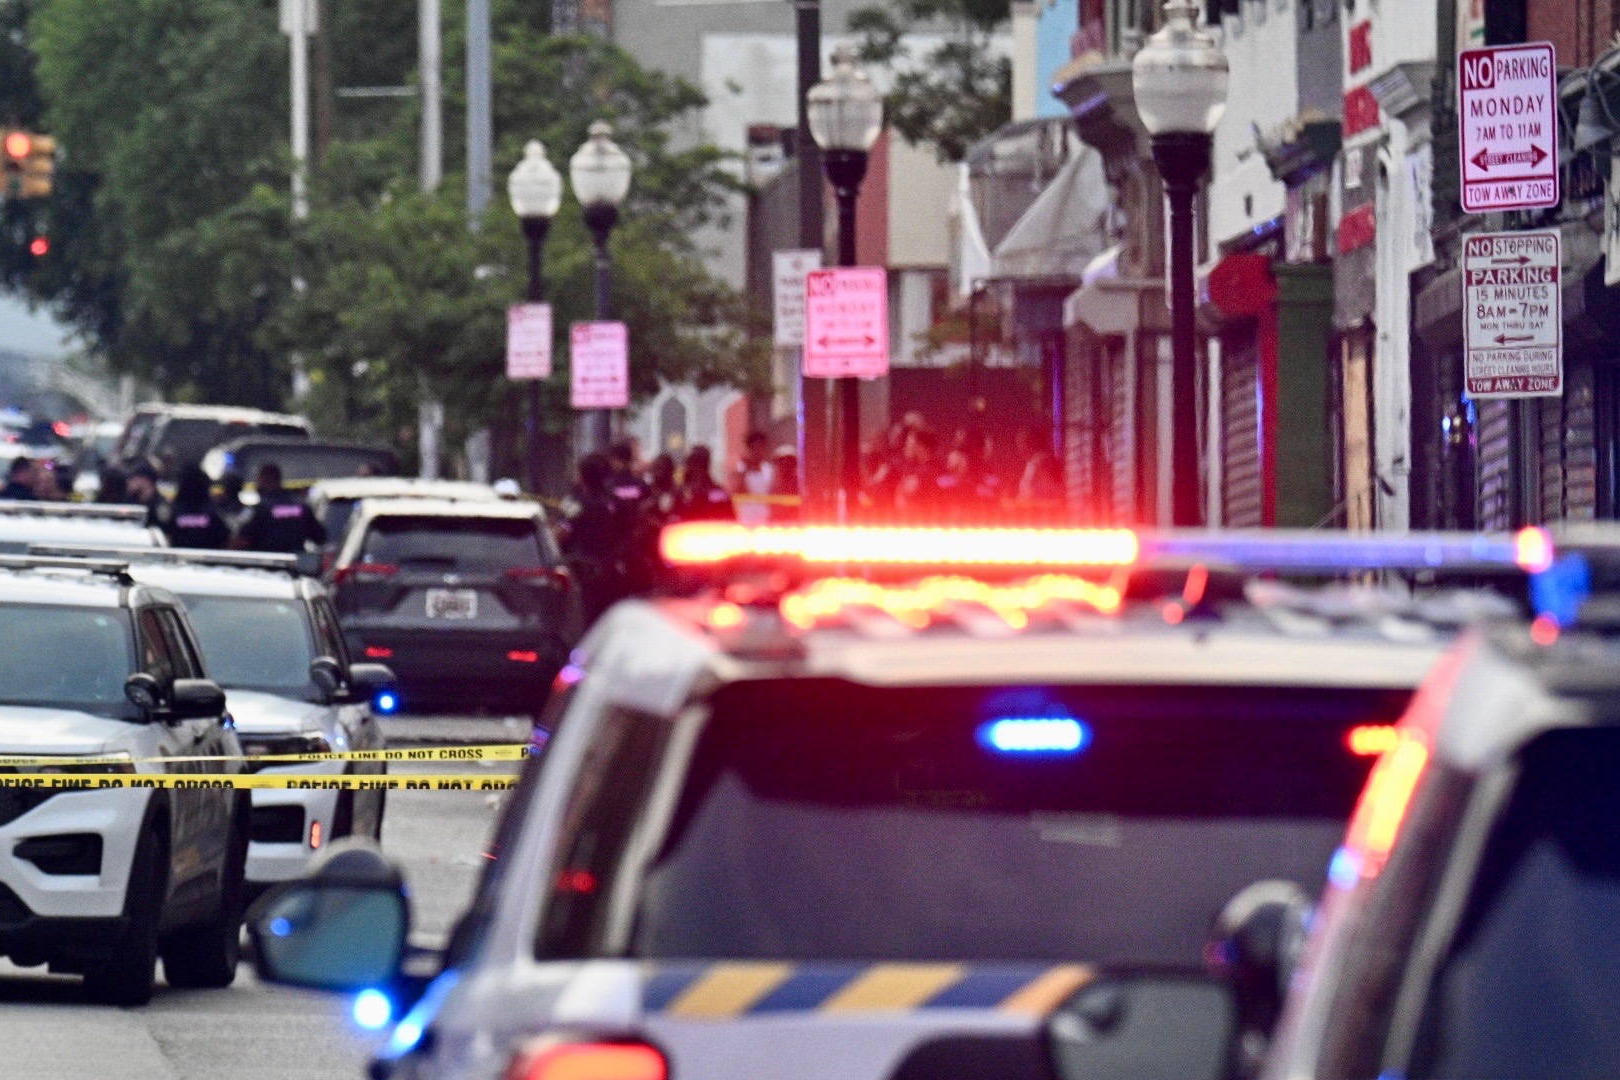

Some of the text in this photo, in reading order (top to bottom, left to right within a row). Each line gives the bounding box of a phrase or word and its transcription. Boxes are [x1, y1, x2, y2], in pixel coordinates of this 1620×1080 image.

[1464, 56, 1548, 88] NO PARKING
[1470, 95, 1544, 117] MONDAY
[1476, 122, 1542, 142] 7AM TO 11AM
[1480, 150, 1538, 166] STREET CLEANING
[1468, 182, 1552, 203] TOW AWAY ZONE
[1468, 238, 1553, 257] NO STOPPING
[1471, 269, 1552, 285] PARKING
[1476, 285, 1549, 300] 15 MINUTES
[1480, 321, 1545, 331] MON THRU SAT
[1472, 350, 1553, 363] NO PARKING DURING
[1472, 365, 1496, 375] STREET
[1497, 364, 1530, 375] CLEANING
[1472, 378, 1555, 392] TOW AWAY ZONE
[351, 751, 379, 760] LINE
[385, 751, 403, 760] DO
[408, 750, 434, 760] NOT
[439, 748, 484, 759] CROSS
